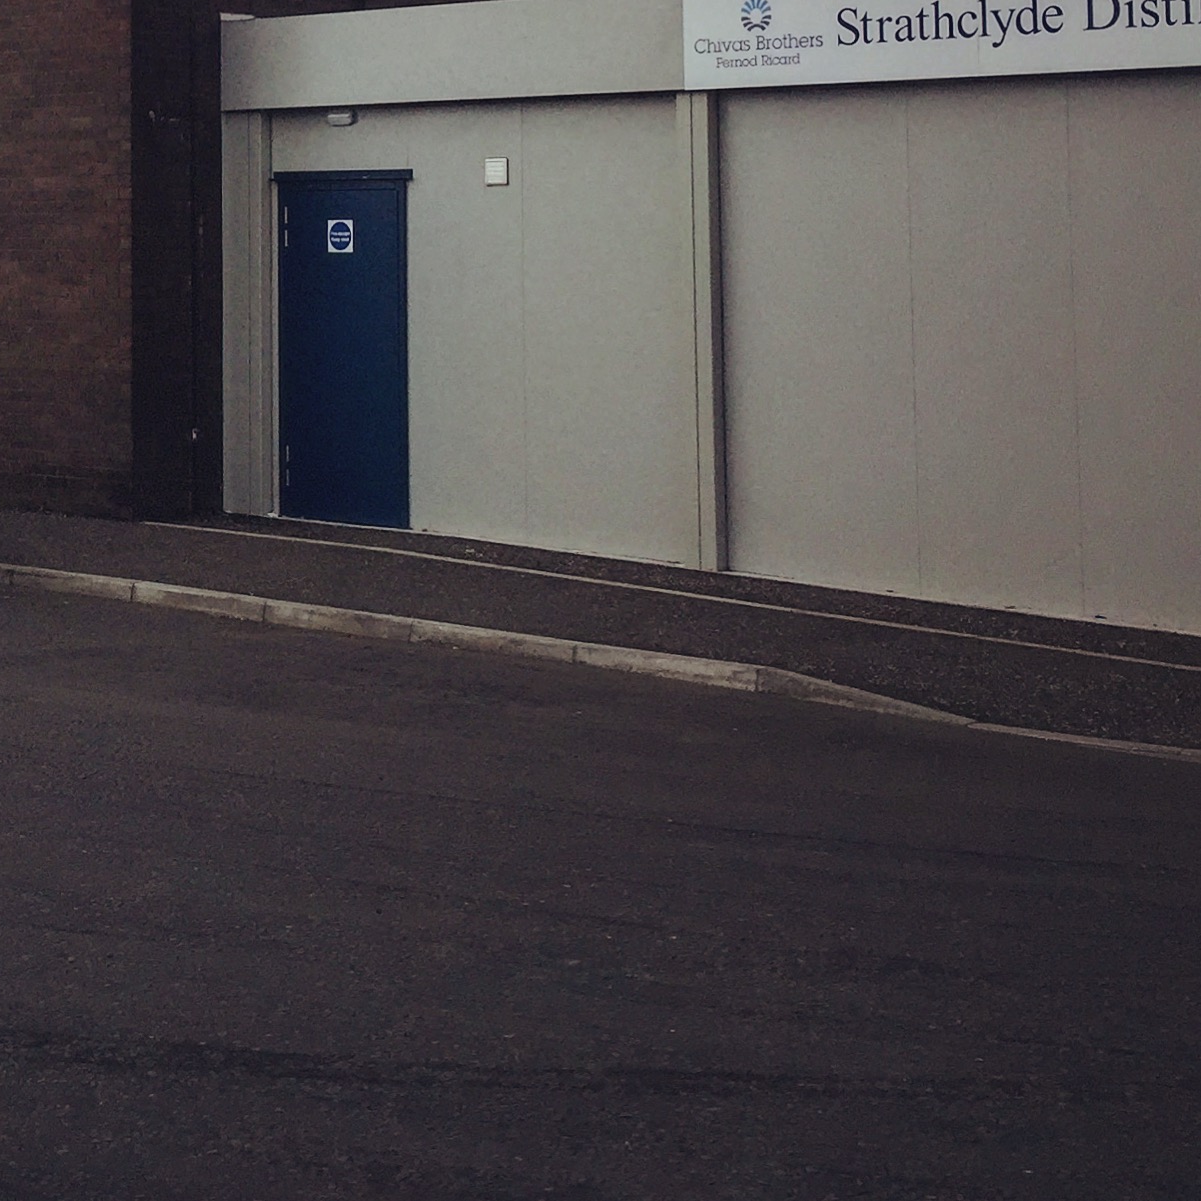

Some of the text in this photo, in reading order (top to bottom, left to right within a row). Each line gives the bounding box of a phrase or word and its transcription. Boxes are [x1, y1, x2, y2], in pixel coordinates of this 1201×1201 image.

[693, 33, 824, 54] Chivas Brothers
[761, 53, 801, 67] Ricard
